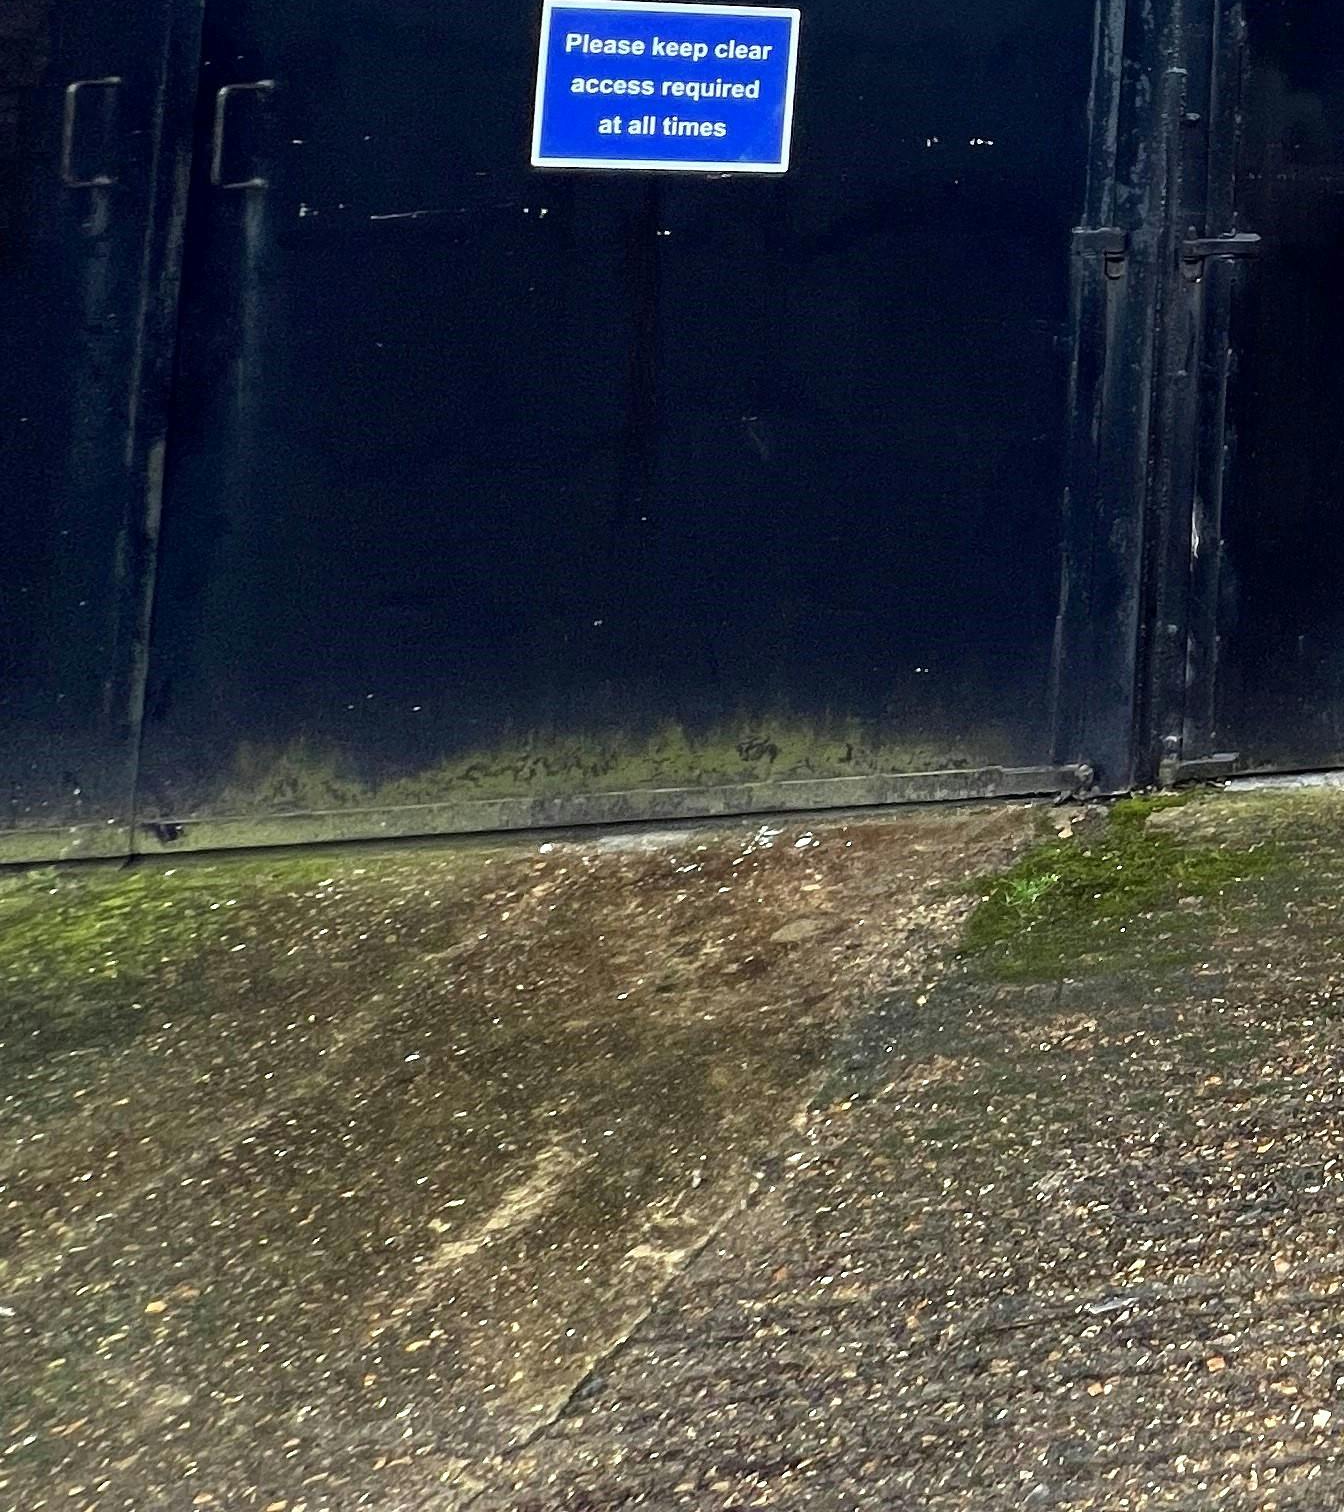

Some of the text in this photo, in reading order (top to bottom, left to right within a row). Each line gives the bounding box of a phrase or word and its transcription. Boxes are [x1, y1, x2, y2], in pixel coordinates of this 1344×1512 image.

[565, 33, 773, 61] Please keep clear
[570, 76, 760, 101] access required
[598, 116, 727, 137] at all times
